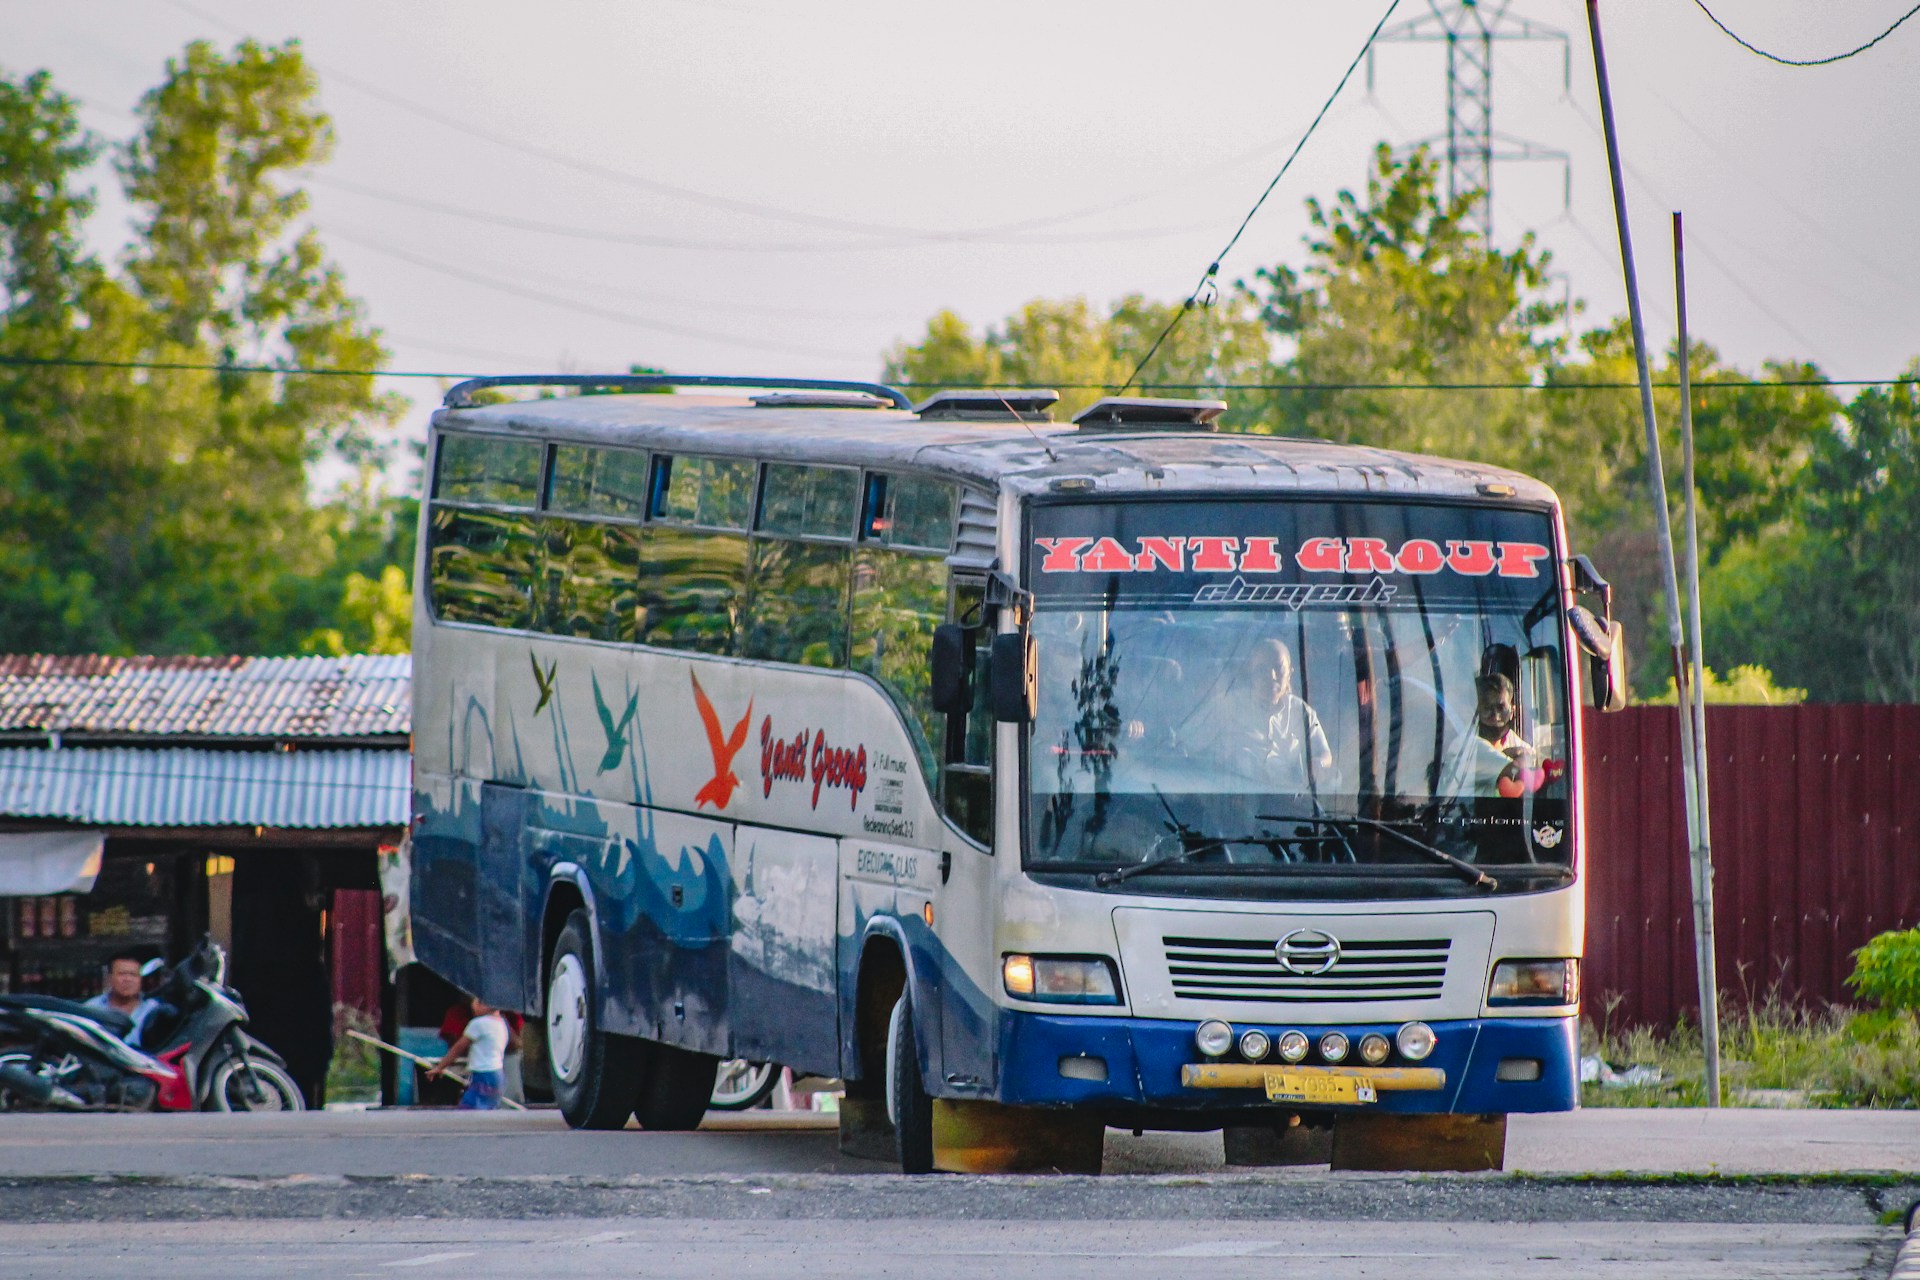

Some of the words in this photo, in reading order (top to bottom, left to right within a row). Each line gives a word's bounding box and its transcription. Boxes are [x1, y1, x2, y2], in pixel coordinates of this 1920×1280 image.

[1034, 536, 1282, 572] YANTI
[1295, 537, 1549, 578] GROUP
[760, 714, 810, 799] Yanti
[811, 728, 867, 812] Group
